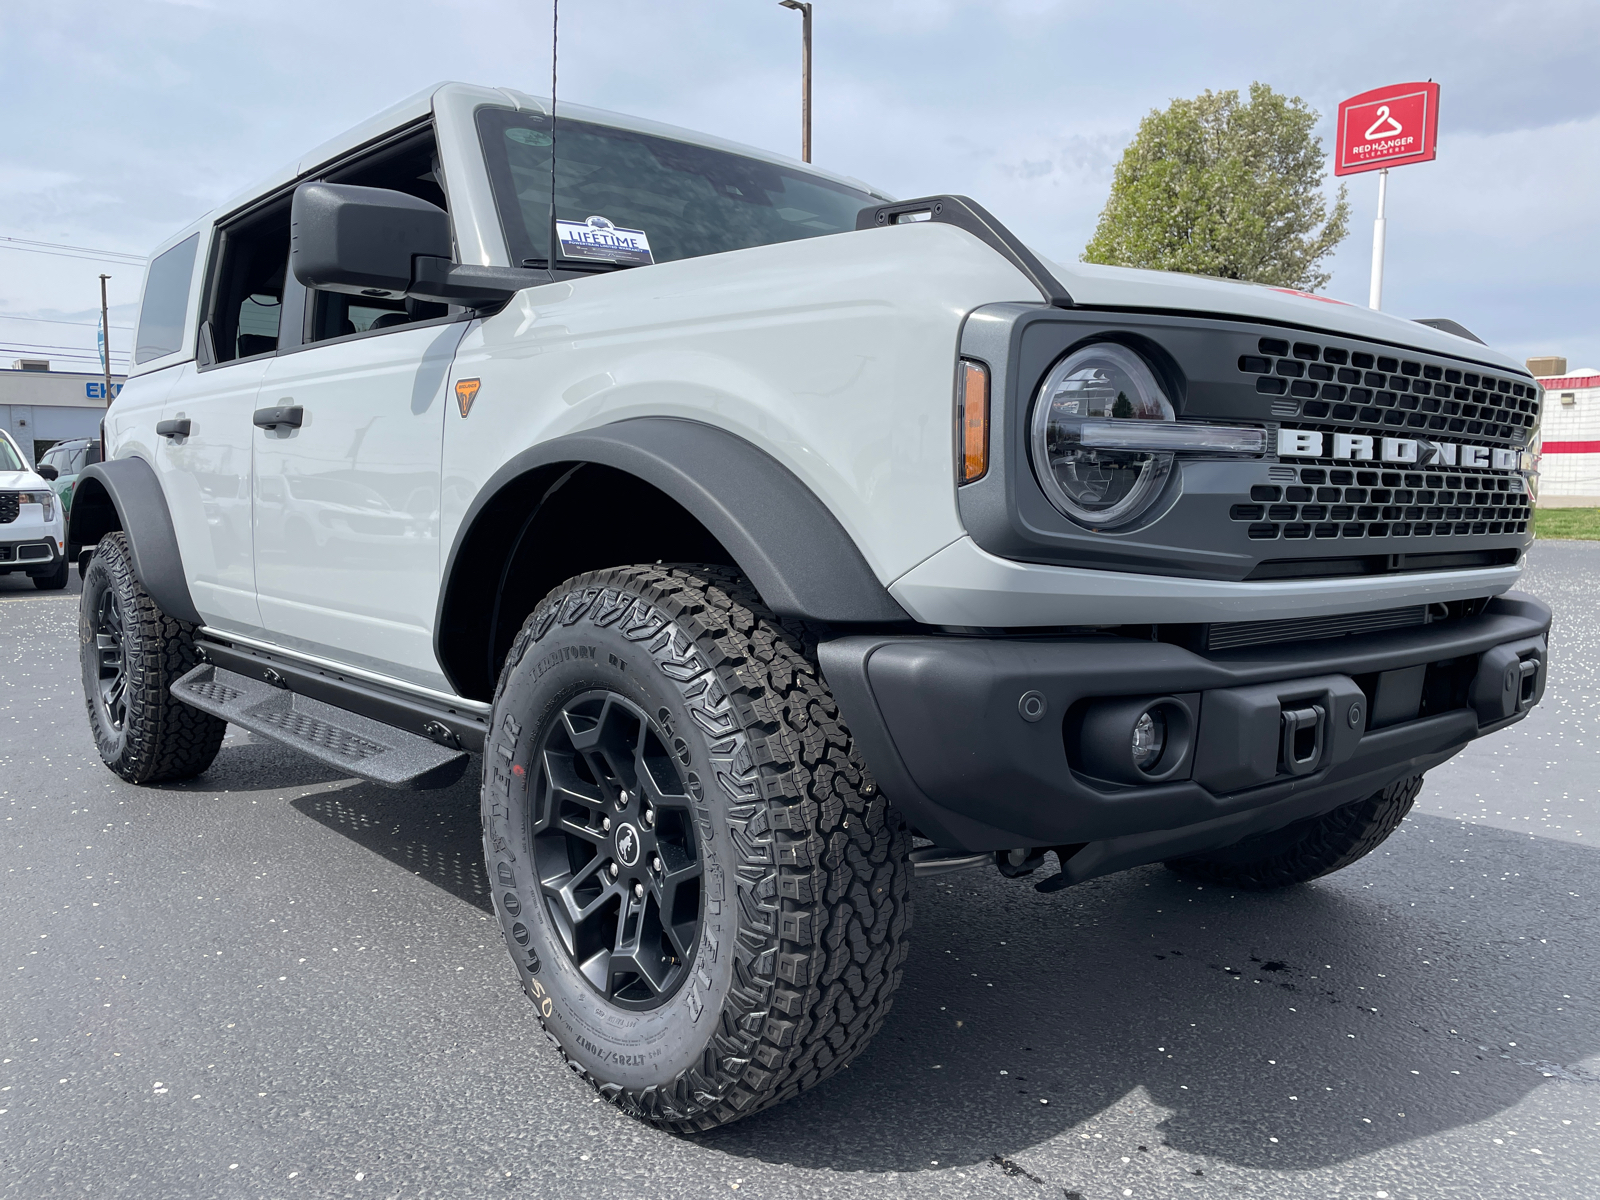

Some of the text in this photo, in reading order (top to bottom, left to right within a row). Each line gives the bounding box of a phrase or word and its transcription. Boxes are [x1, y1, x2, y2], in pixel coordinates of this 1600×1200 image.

[1353, 136, 1413, 154] RED HANGER
[1360, 146, 1404, 158] CLEANERS
[569, 231, 638, 248] LIFETIME
[618, 245, 643, 253] WARRANTY
[1277, 429, 1517, 470] BRONCO
[529, 645, 628, 684] TERRITORY RT
